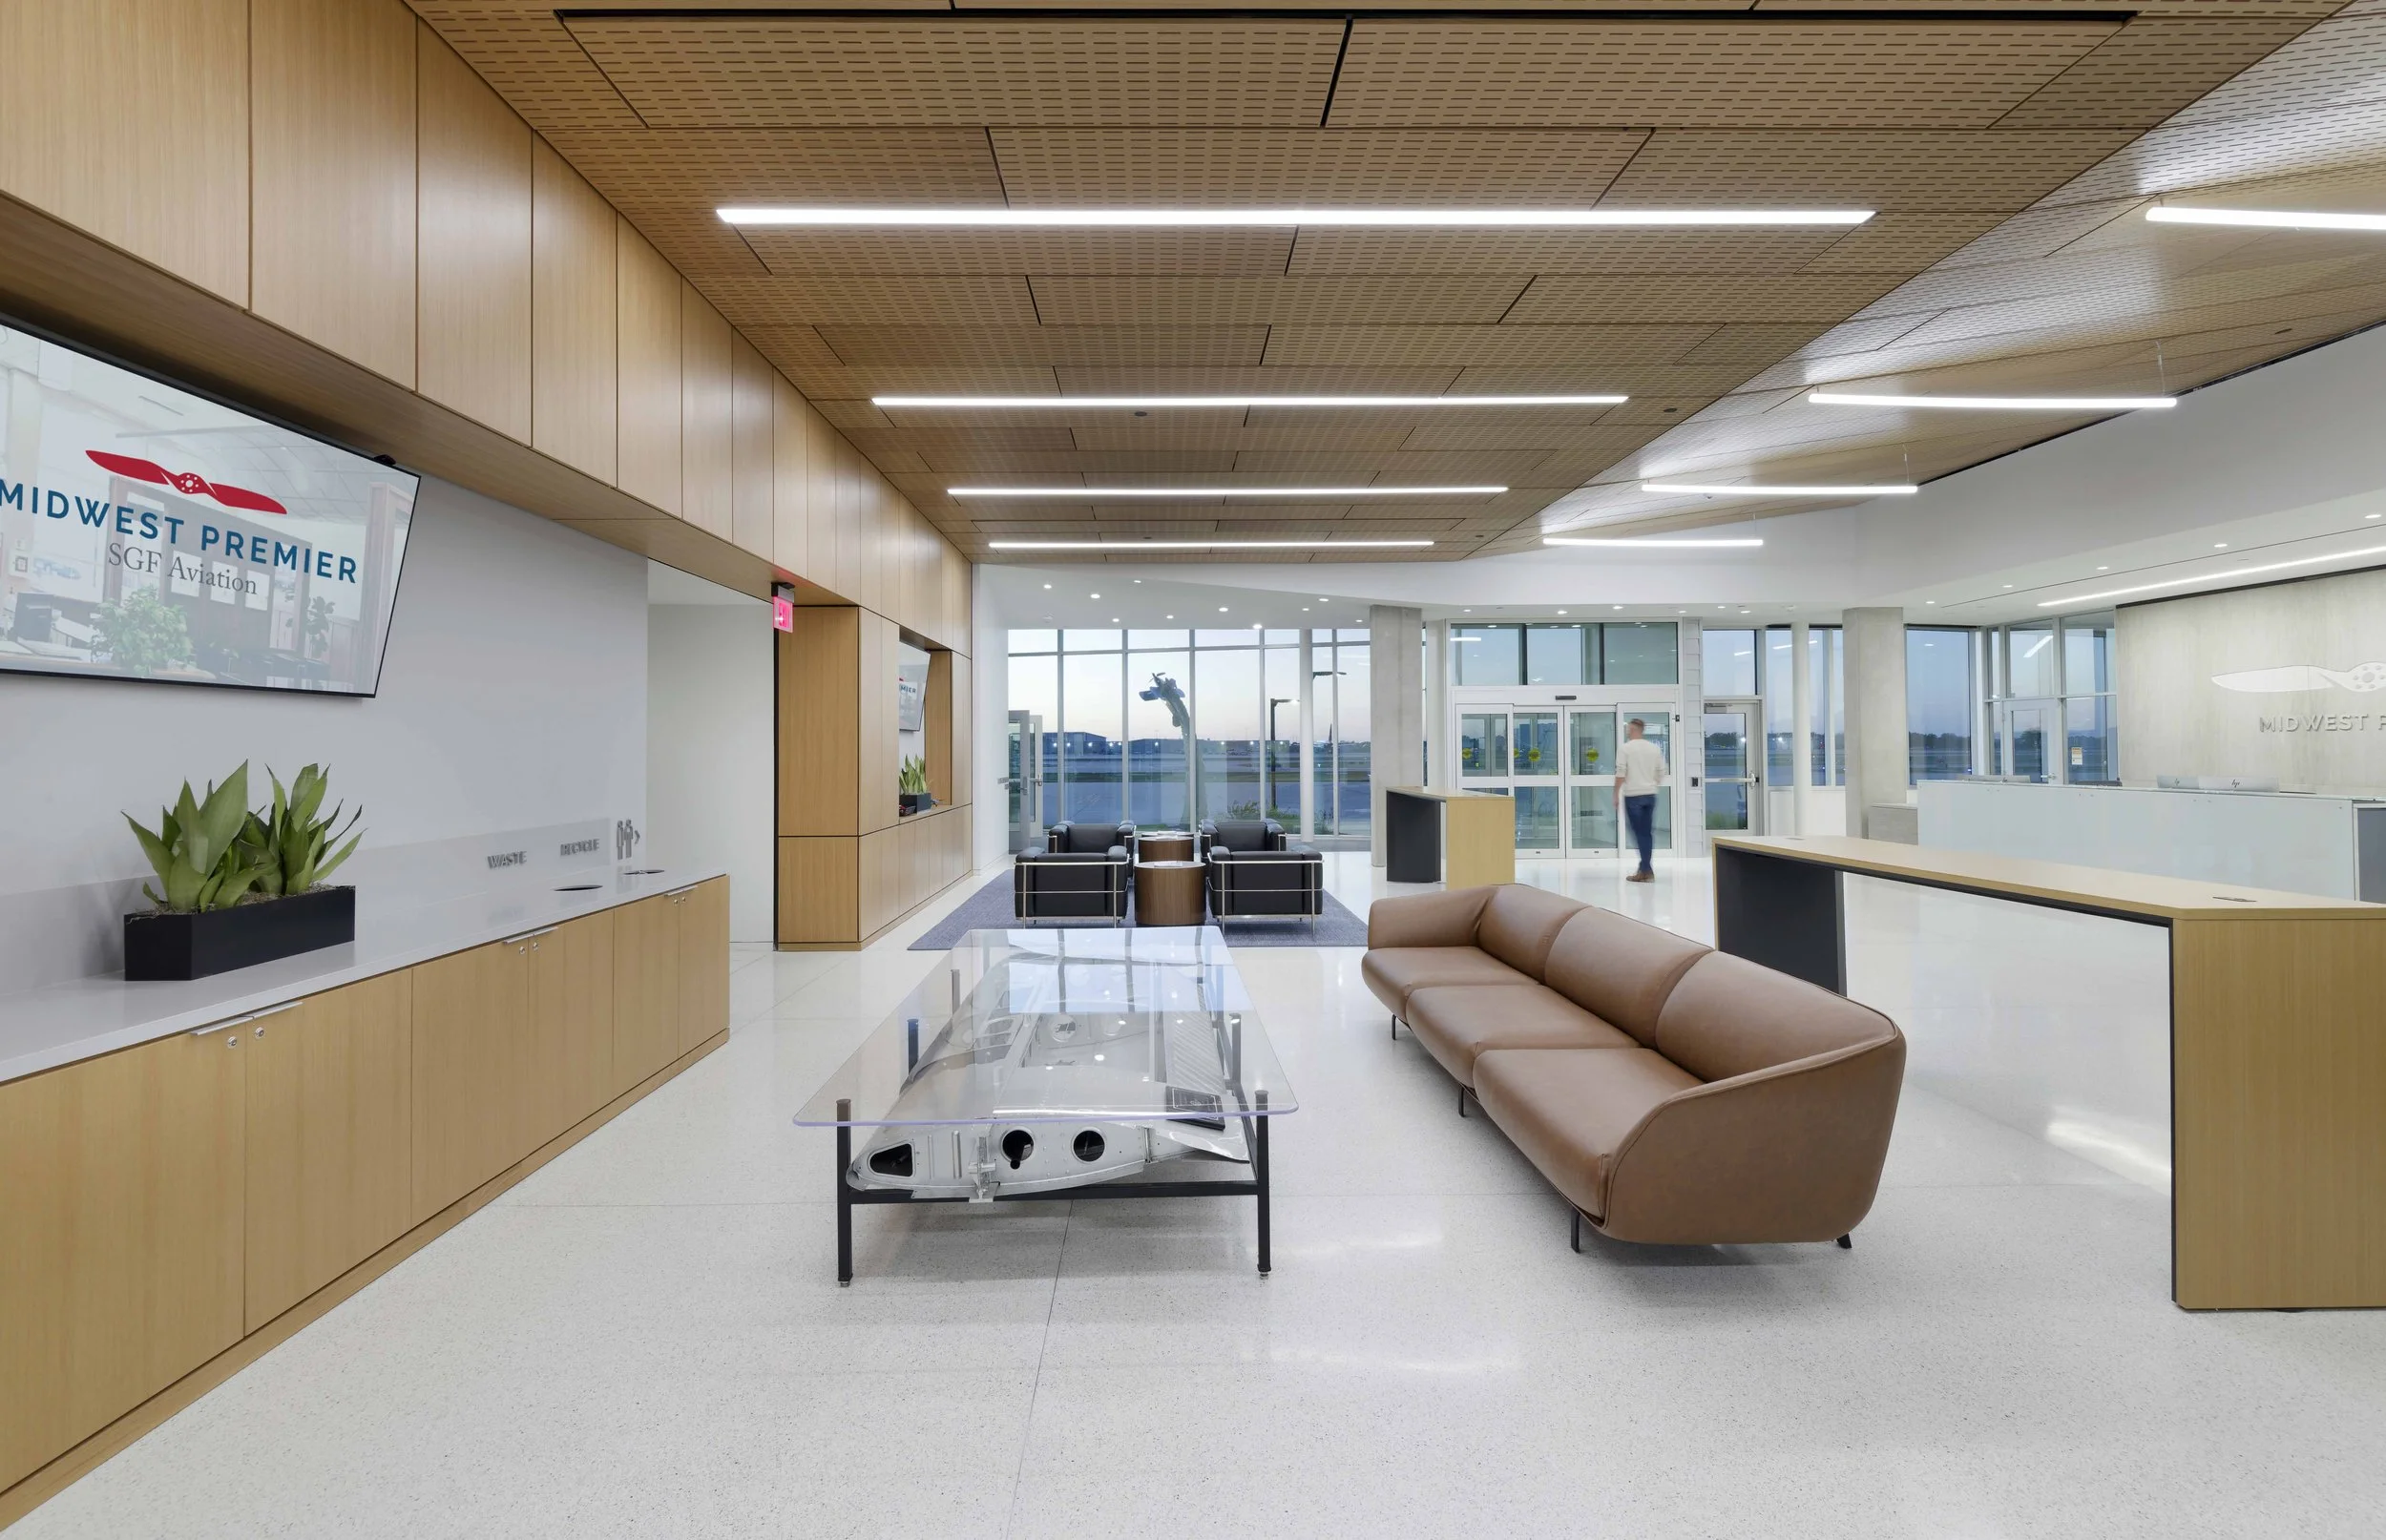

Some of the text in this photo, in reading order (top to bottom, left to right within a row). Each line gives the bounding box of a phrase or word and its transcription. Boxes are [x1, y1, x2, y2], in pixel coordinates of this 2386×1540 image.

[0, 478, 358, 584] MIDWEST PREMIER
[108, 542, 258, 596] SGF Aviation
[2259, 714, 2369, 732] MIDWEST
[487, 851, 527, 869] WASTE
